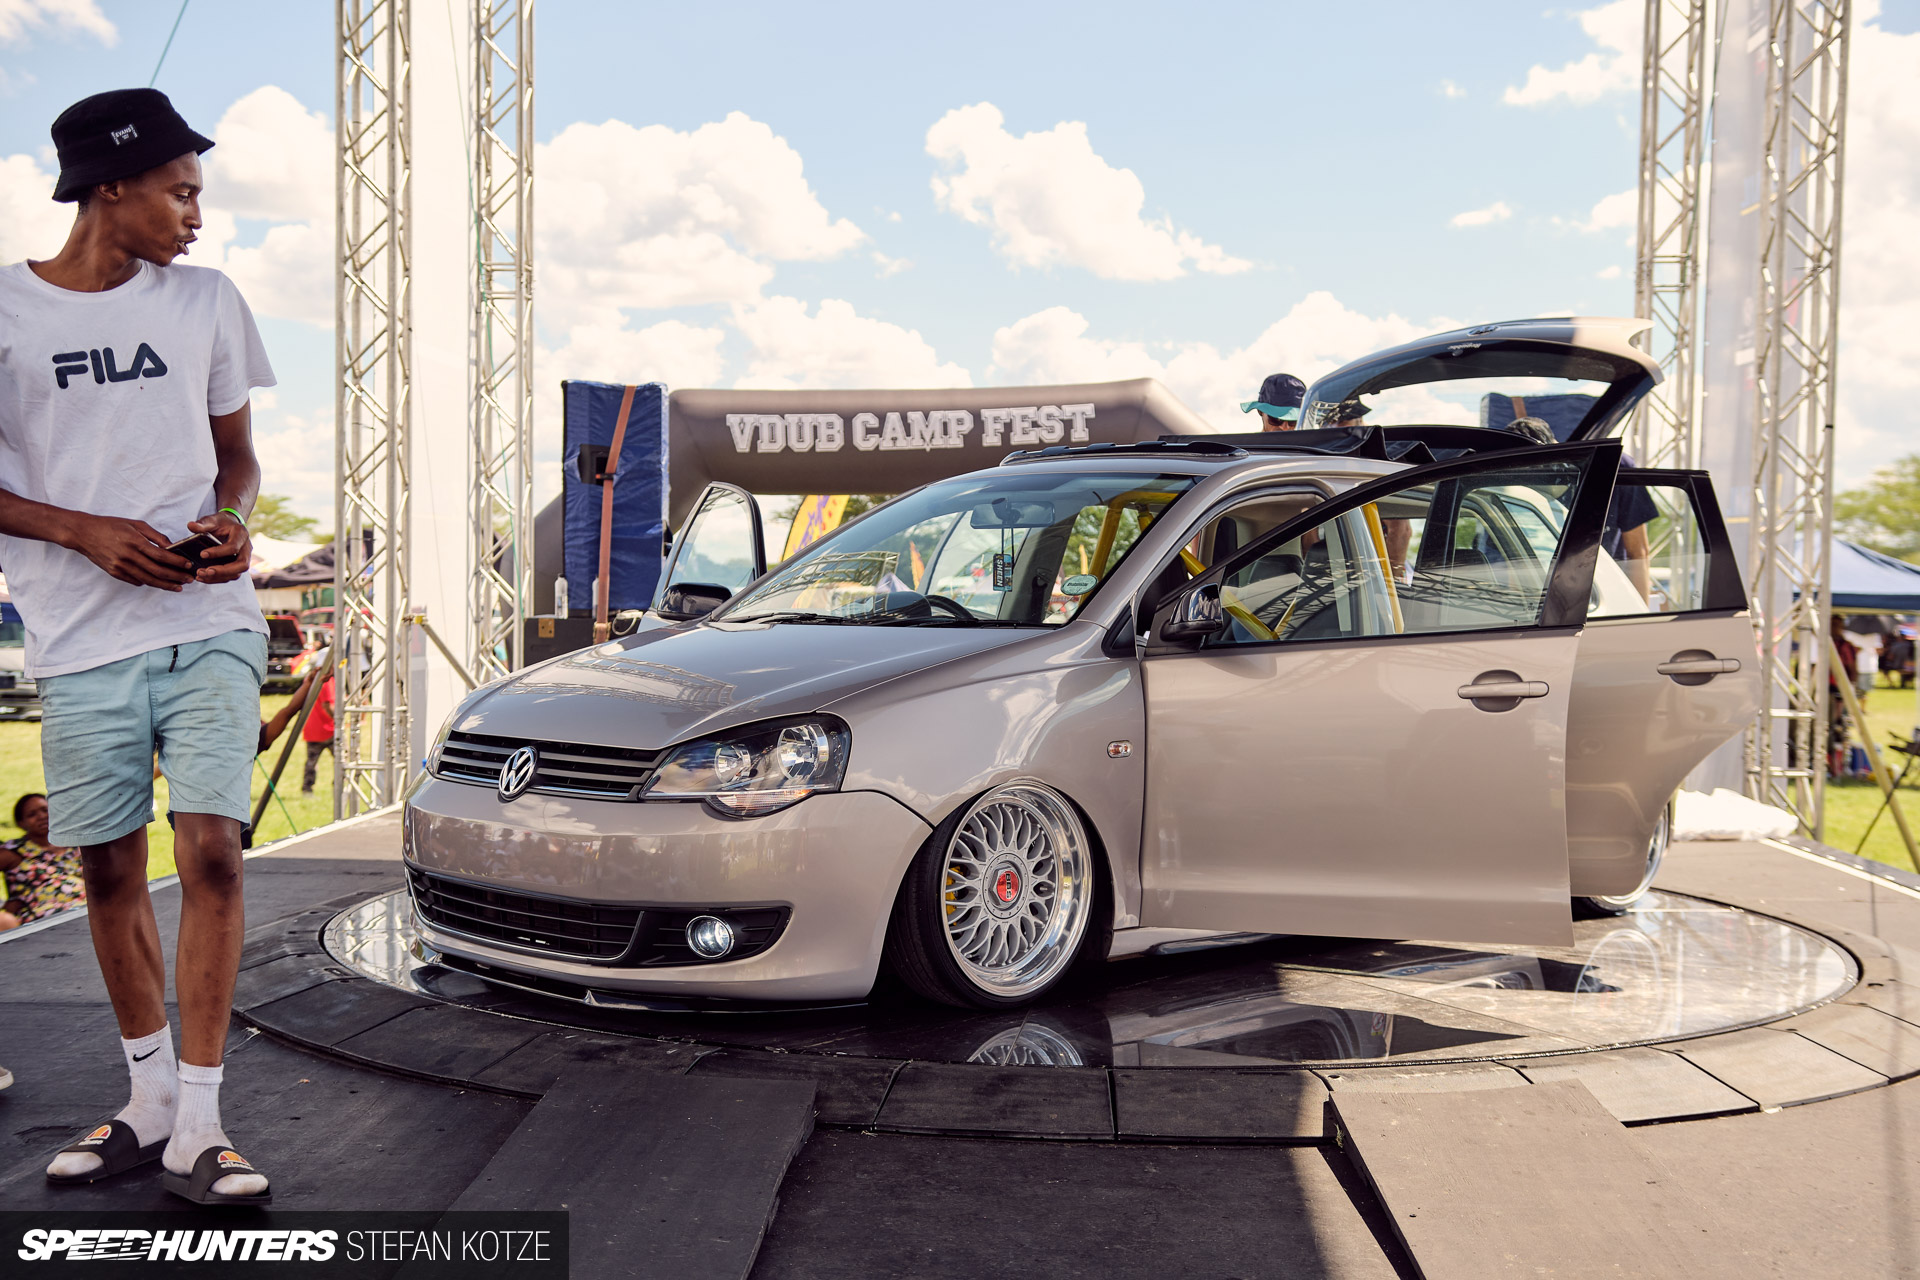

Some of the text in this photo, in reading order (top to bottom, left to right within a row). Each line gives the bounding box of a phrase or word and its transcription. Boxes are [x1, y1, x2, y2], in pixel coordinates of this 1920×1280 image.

[52, 342, 168, 390] FILA
[725, 403, 1096, 453] VDUB CAMP FEST
